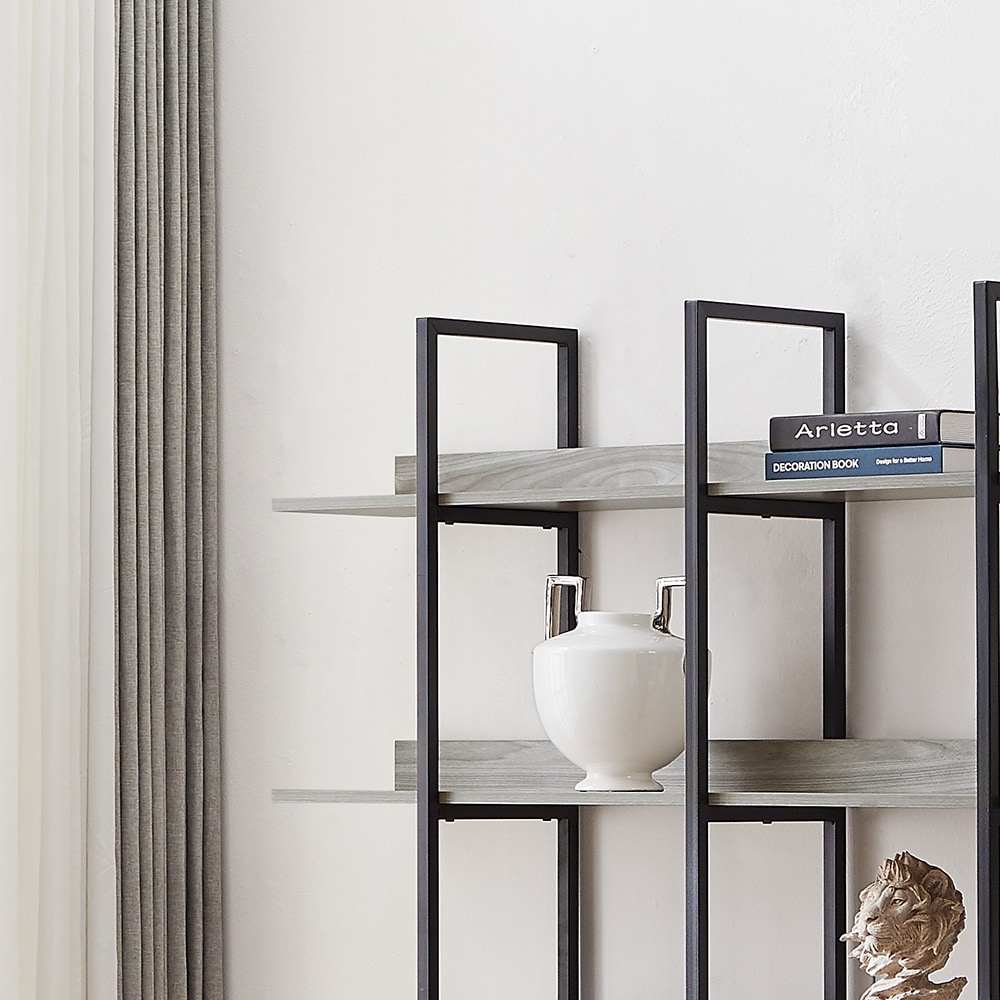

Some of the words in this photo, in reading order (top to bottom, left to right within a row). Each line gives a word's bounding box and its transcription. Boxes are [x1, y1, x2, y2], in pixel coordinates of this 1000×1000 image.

[794, 420, 899, 439] Arletta
[773, 460, 830, 472] DECORATION
[832, 459, 859, 469] BOOK
